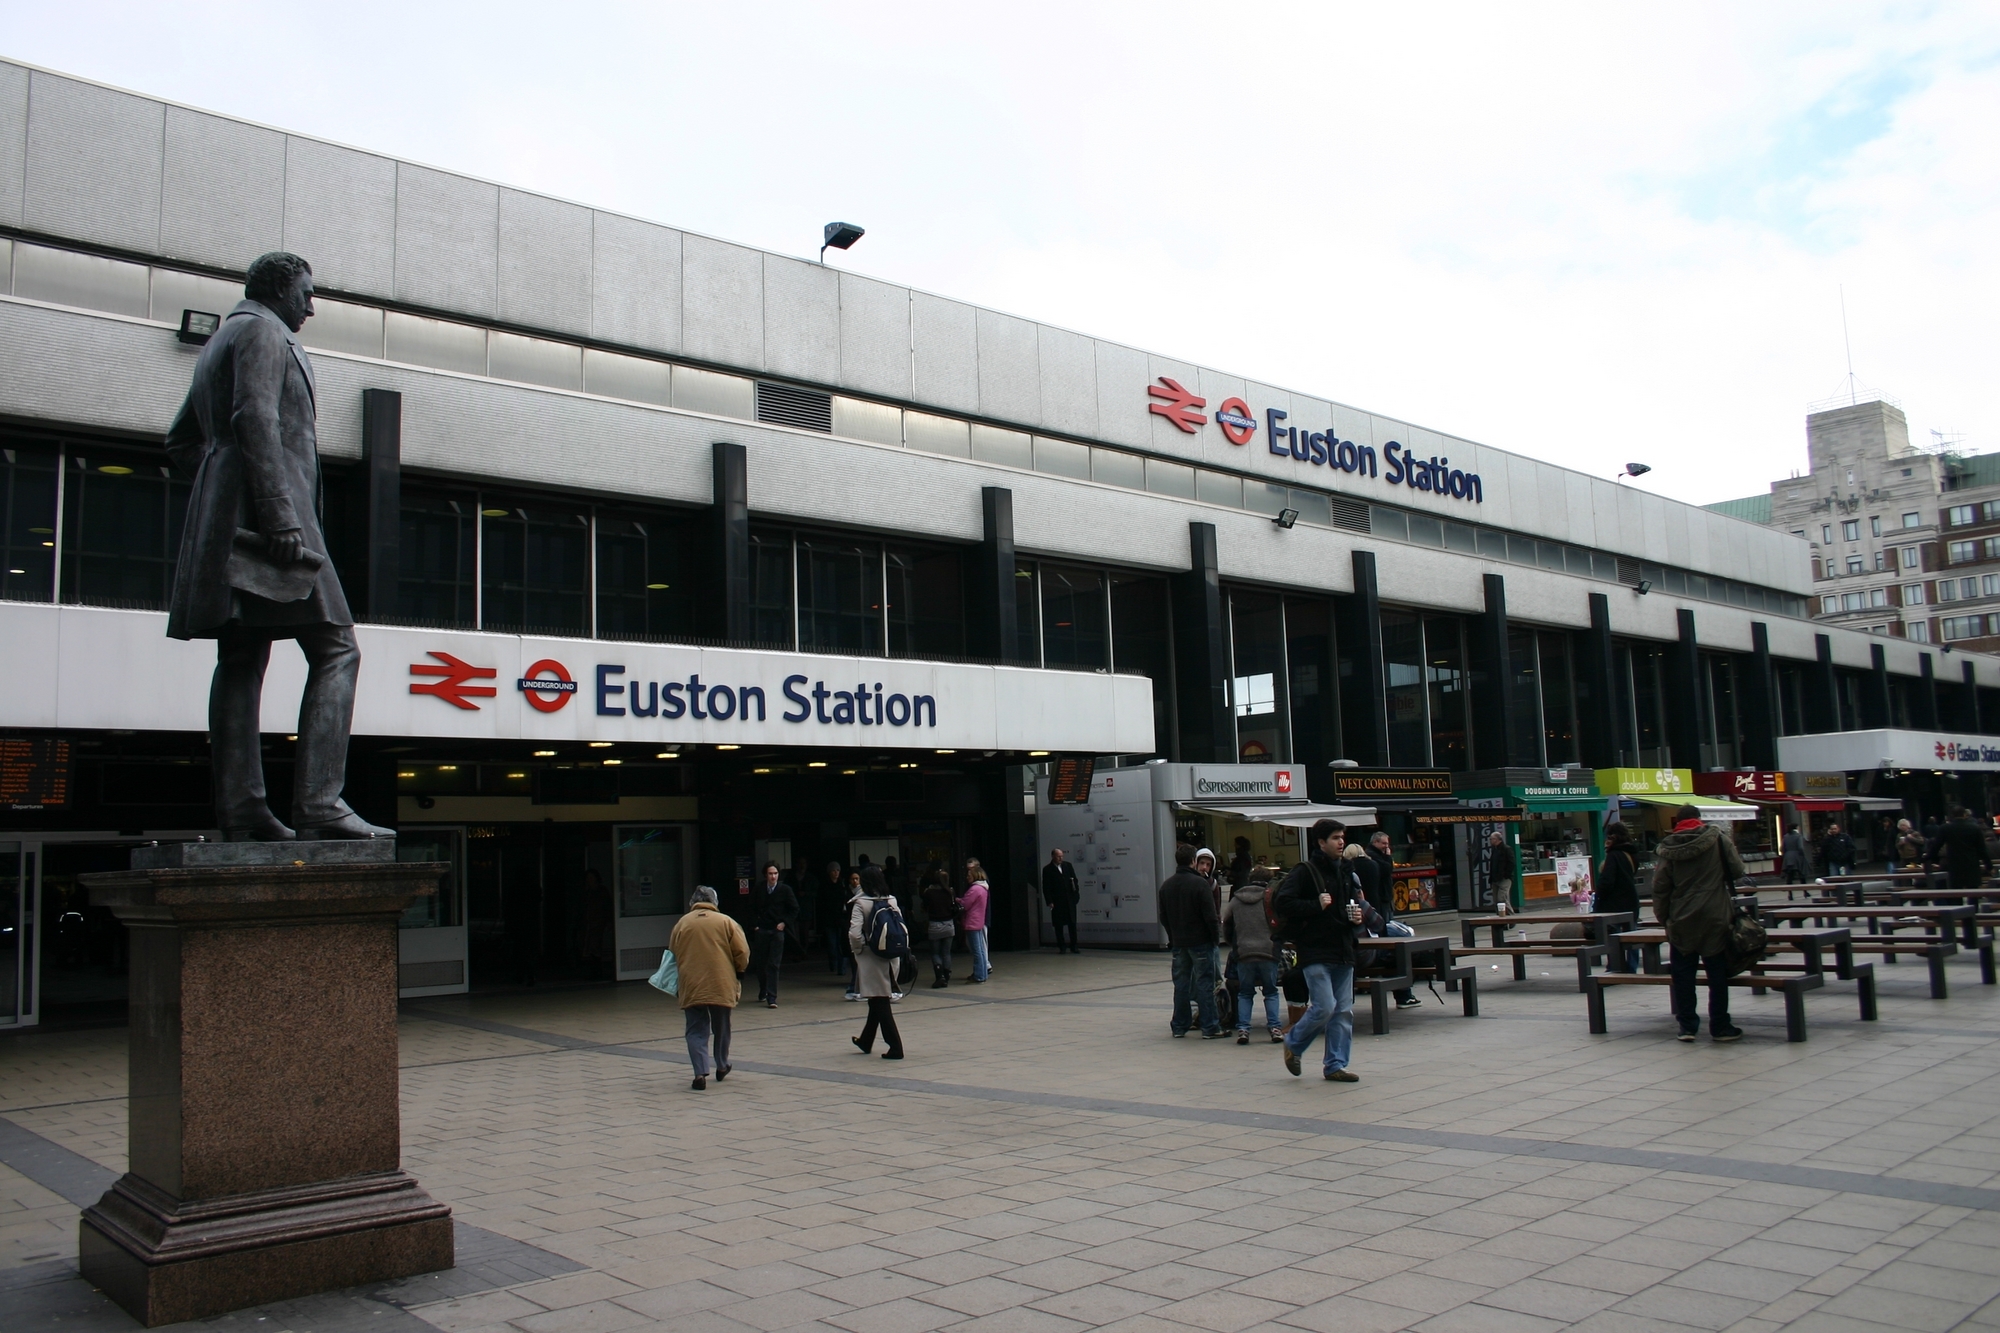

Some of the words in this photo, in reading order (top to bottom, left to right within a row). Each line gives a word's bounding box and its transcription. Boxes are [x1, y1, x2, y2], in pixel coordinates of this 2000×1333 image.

[1220, 414, 1255, 427] UNDERGROUND
[1267, 408, 1377, 478] Euston
[1384, 440, 1482, 503] Station
[522, 681, 574, 690] UNDERGROUND
[596, 664, 766, 721] Euston
[782, 674, 936, 726] Station
[1957, 743, 1979, 761] Euston
[1278, 774, 1290, 790] illy
[1339, 778, 1362, 790] WEST
[1364, 778, 1411, 790] CORNWALL
[1413, 778, 1436, 789] PASTY
[1436, 778, 1448, 789] Co.
[1622, 772, 1649, 791] abokado
